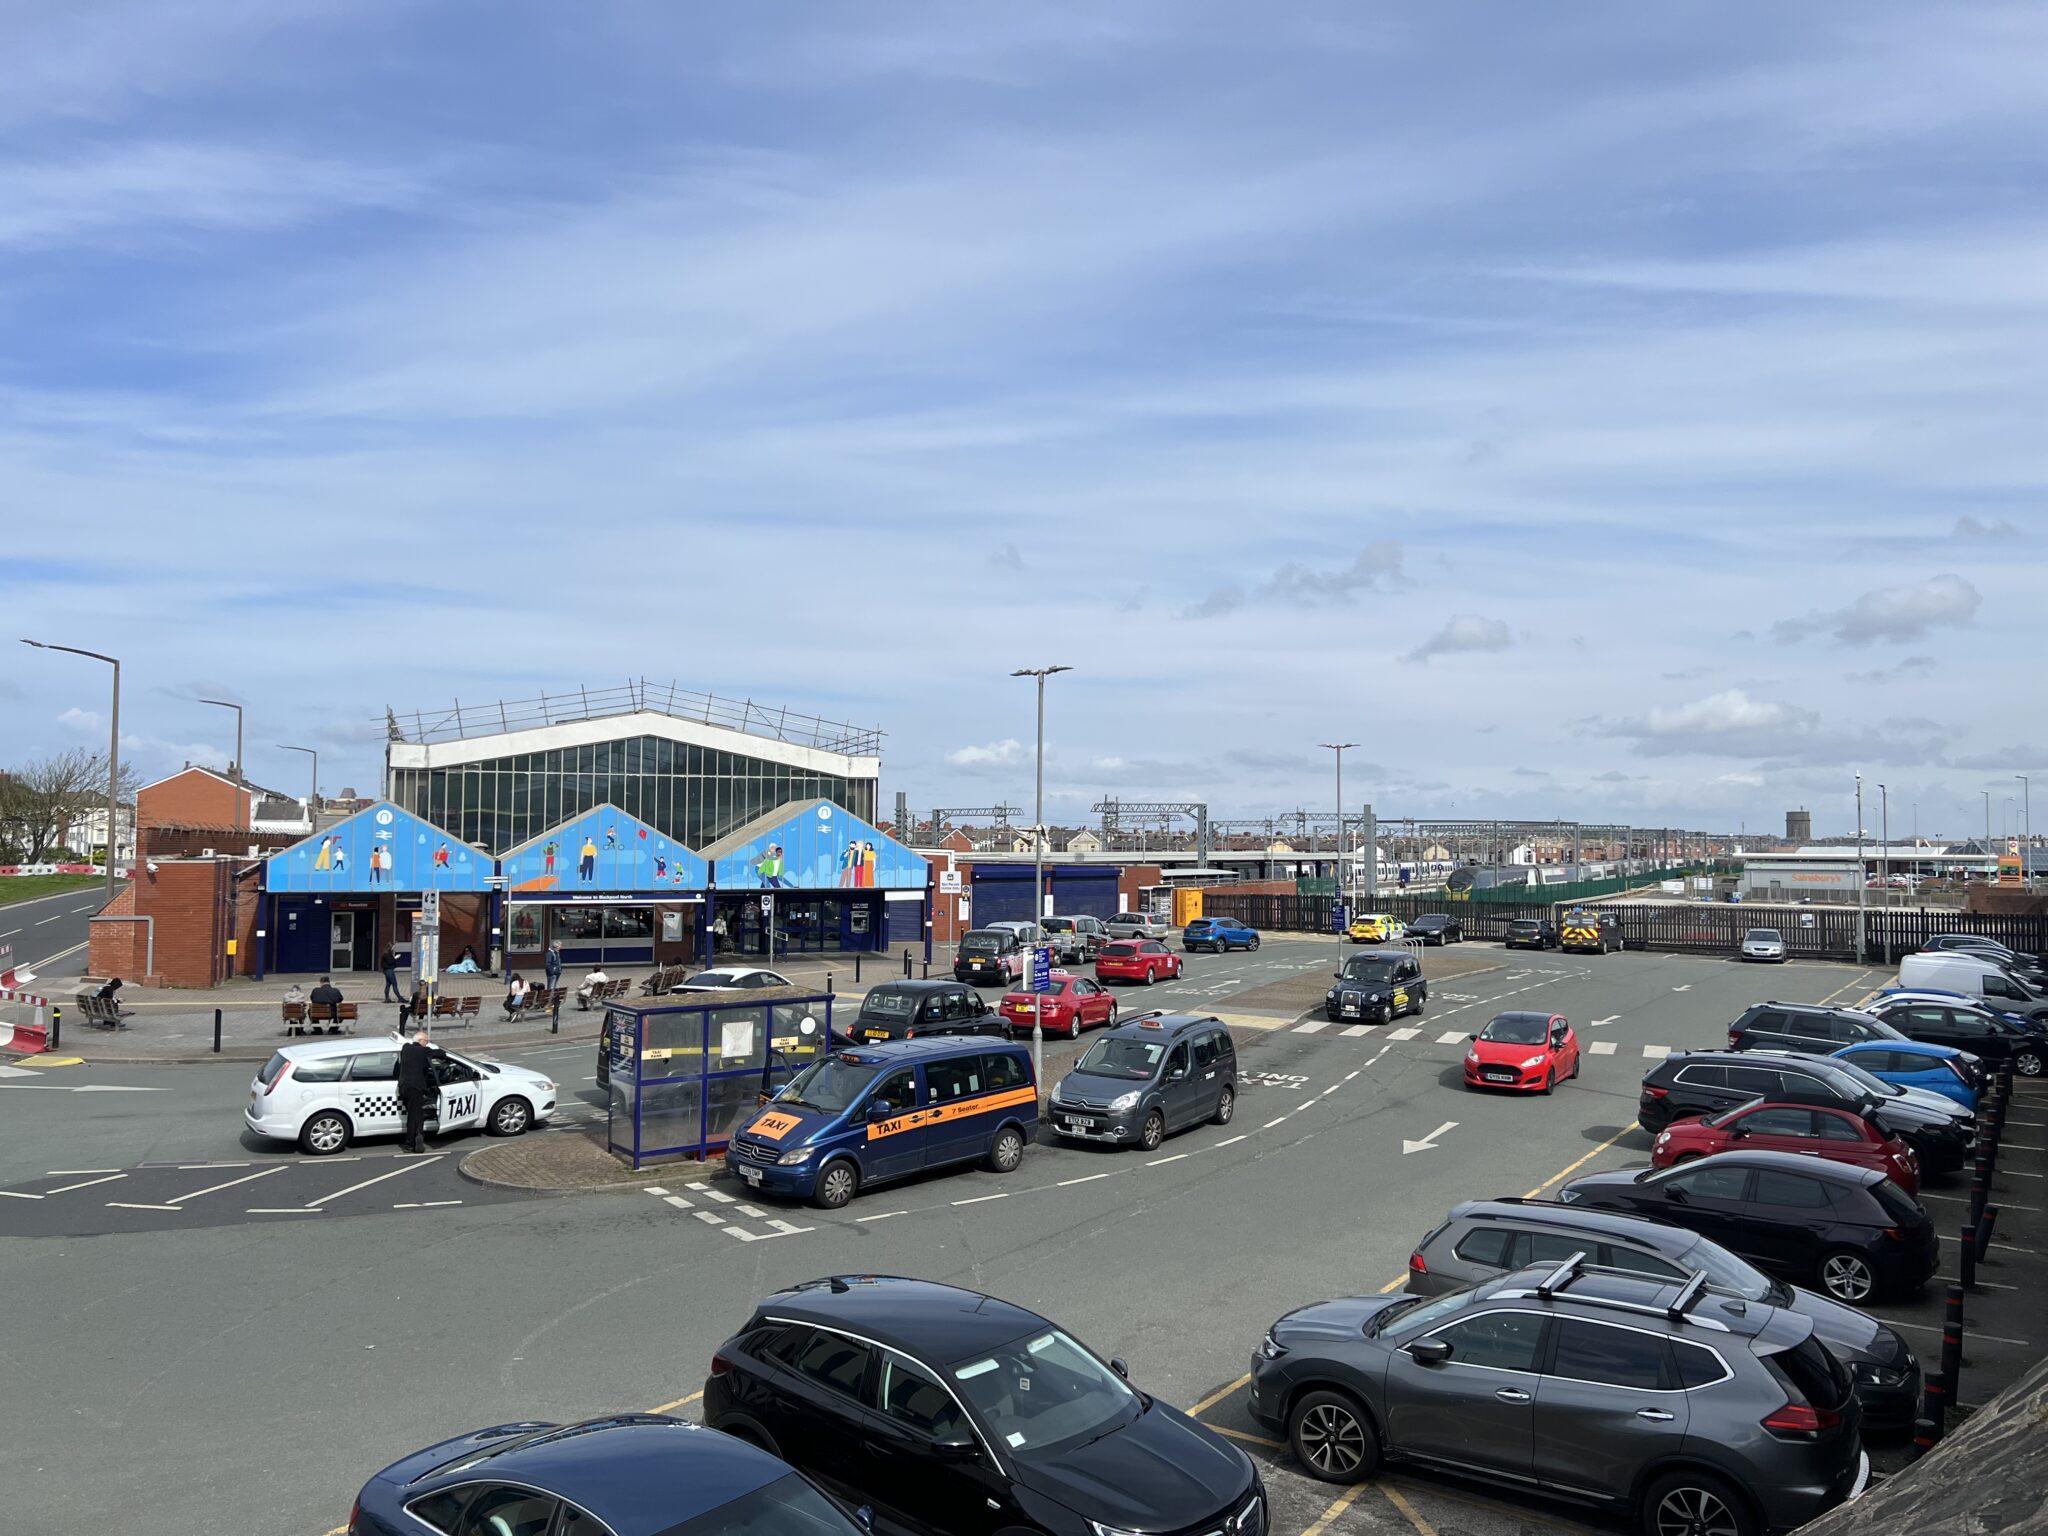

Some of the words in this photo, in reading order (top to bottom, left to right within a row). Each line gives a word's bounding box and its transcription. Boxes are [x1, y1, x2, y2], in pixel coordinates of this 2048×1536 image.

[1791, 872, 1841, 883] Sainsbury's
[448, 1093, 477, 1120] TAXI
[957, 1103, 979, 1113] Seater
[760, 1118, 789, 1132] TAXI
[876, 1119, 902, 1135] TAXI
